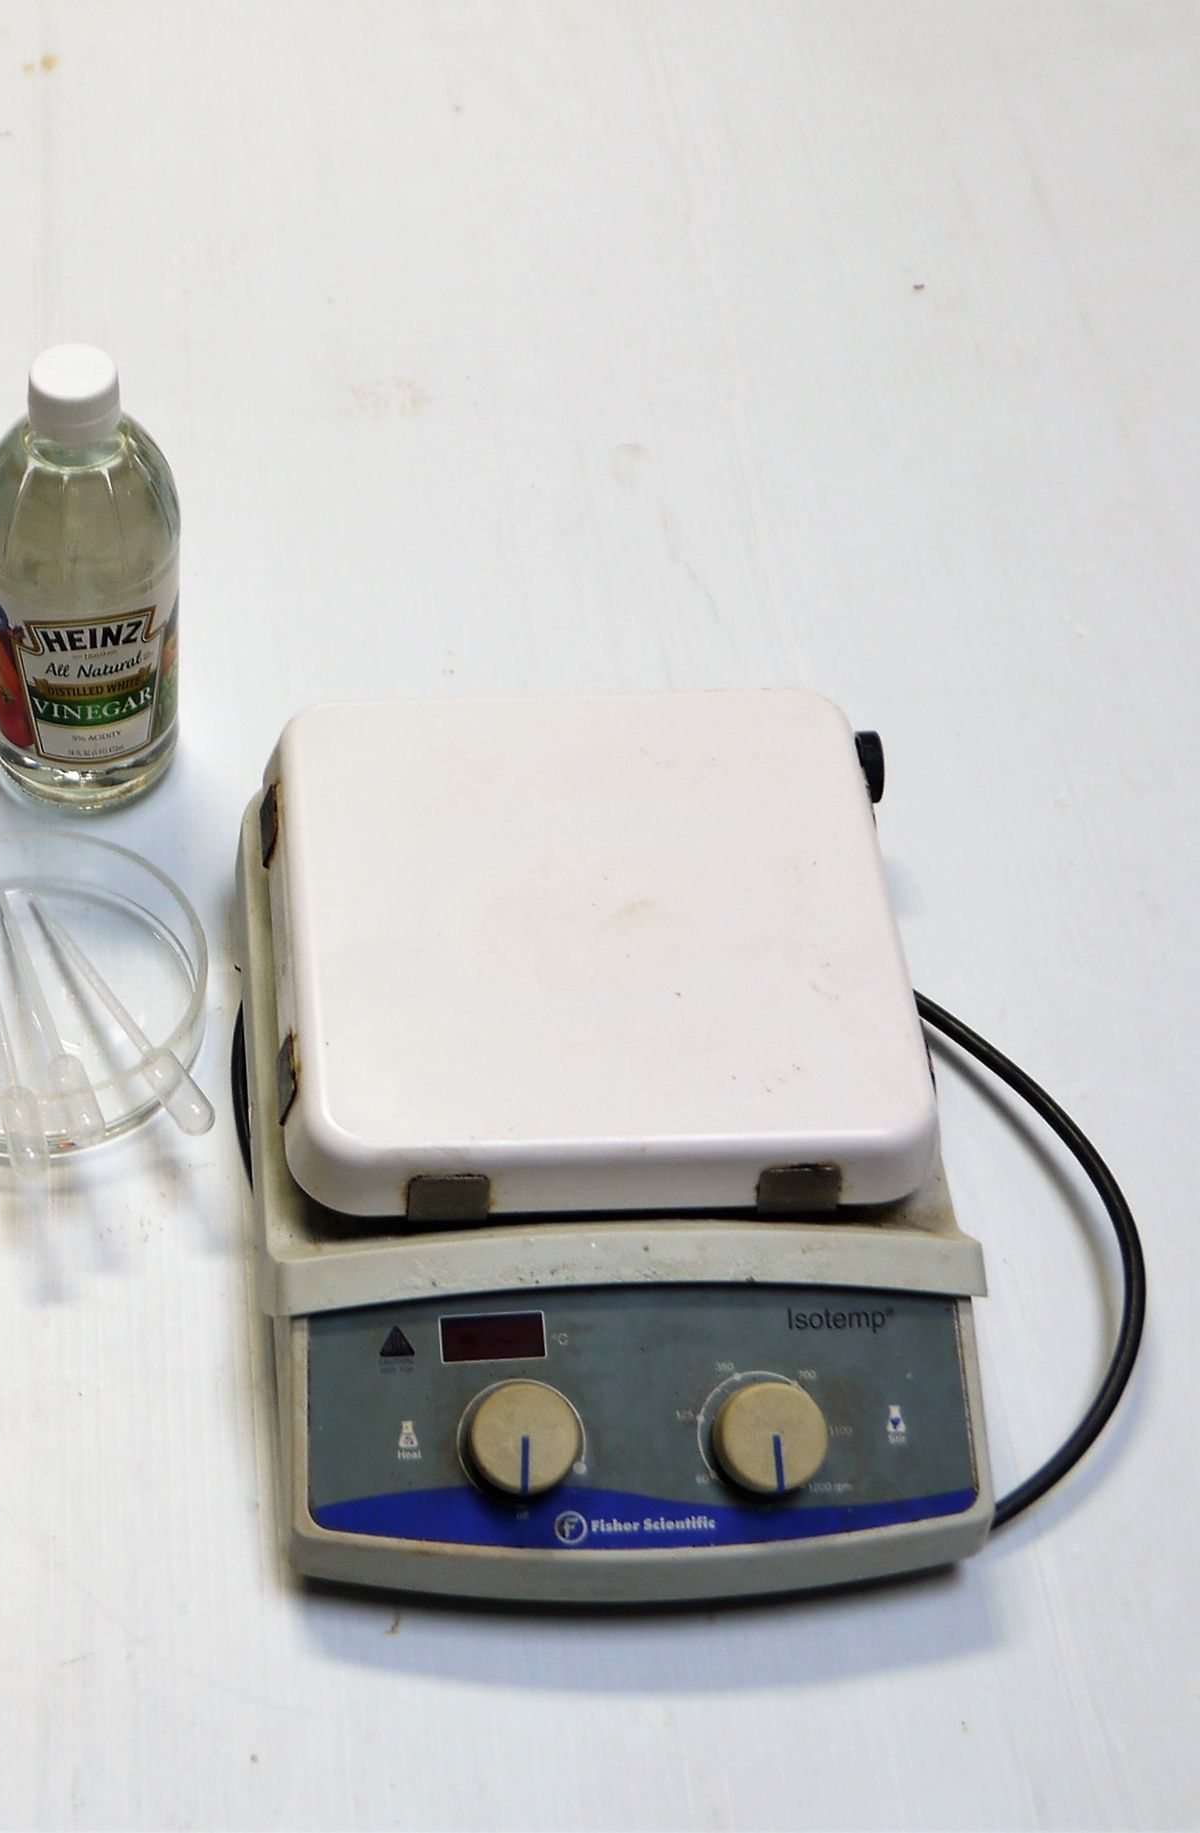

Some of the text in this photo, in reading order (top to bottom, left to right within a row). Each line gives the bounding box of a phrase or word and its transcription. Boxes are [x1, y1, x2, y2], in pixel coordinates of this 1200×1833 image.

[40, 619, 143, 652] HEINZ
[45, 661, 70, 678] All
[76, 650, 142, 678] Natural
[47, 678, 141, 697] DISTILLED WHITE
[32, 686, 153, 720] VINEGAR
[88, 728, 123, 741] ACIDITY
[714, 1361, 735, 1373] 350
[798, 1369, 817, 1381] 700
[397, 1450, 422, 1460] Heat
[808, 1481, 833, 1492] 1200
[591, 1519, 640, 1533] Fisher
[643, 1515, 716, 1531] Scientific
